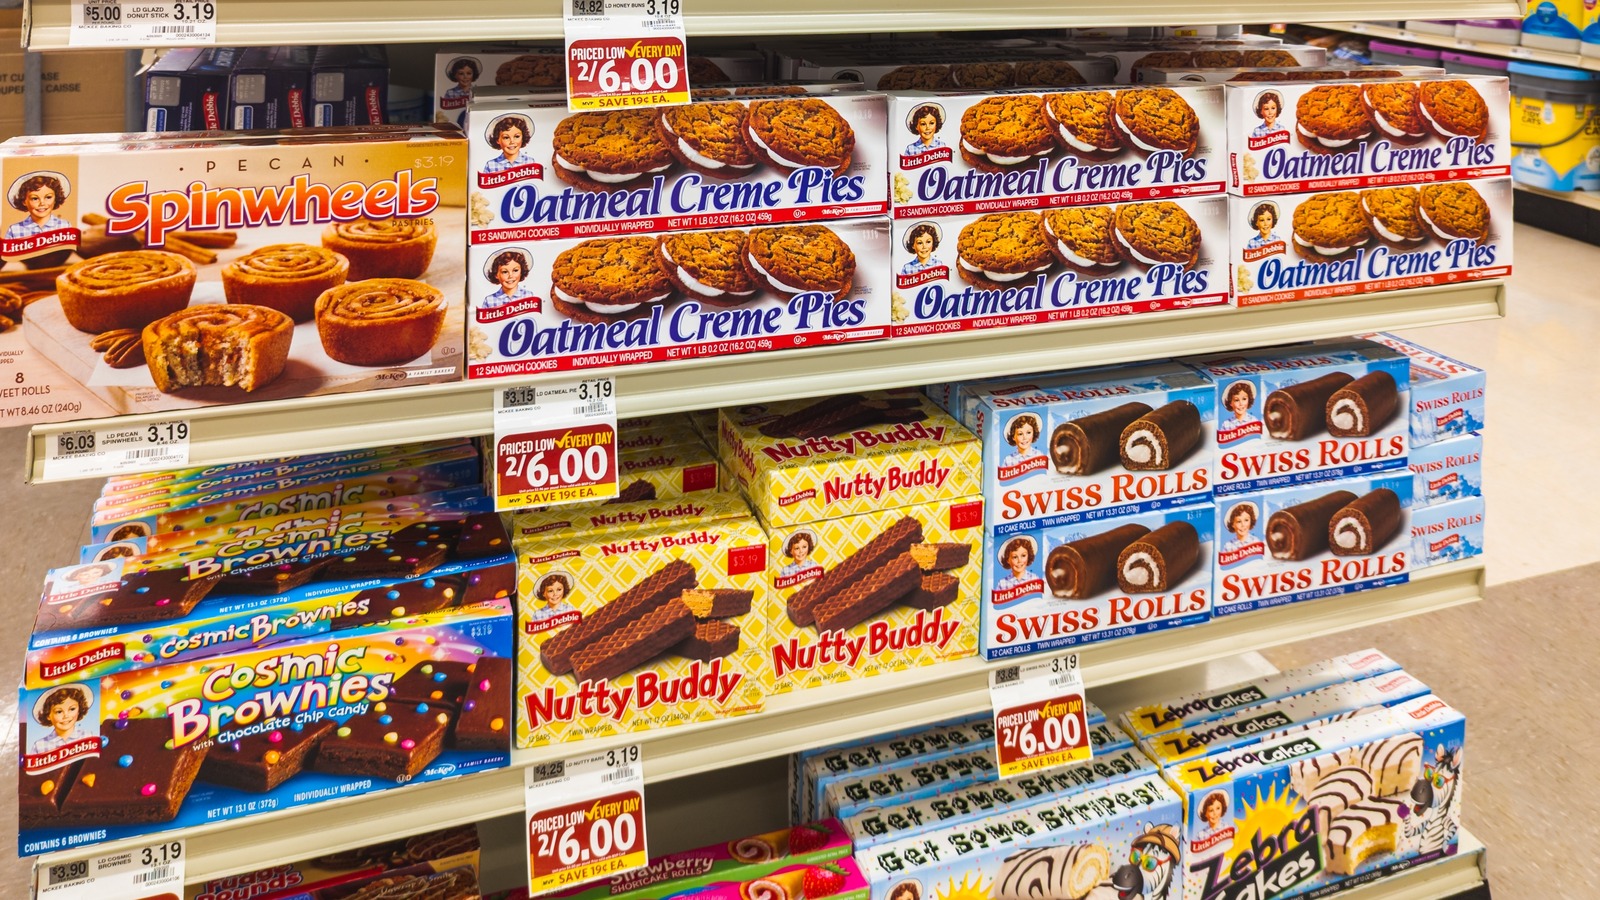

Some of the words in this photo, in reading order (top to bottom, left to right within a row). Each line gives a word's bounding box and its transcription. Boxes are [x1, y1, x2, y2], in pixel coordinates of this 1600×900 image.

[86, 6, 121, 20] $5.00
[174, 3, 214, 20] 3.19
[574, 0, 603, 13] $4.82
[571, 48, 604, 60] PRICED
[606, 46, 626, 59] LOW
[636, 45, 664, 58] EVERY
[665, 44, 682, 57] DAY
[46, 83, 81, 93] CAISSE
[599, 97, 629, 107] SAVE
[632, 96, 649, 105] 19¢
[652, 95, 670, 103] EA.
[1522, 116, 1541, 125] CATS
[206, 156, 344, 172] PECAN
[414, 156, 455, 169] $3.19
[902, 155, 923, 167] Little
[924, 150, 950, 162] Debbie
[1263, 142, 1367, 179] Oatmeal
[1370, 141, 1442, 173] Creme
[1446, 136, 1495, 166] Pies
[918, 158, 1049, 201] Oatmeal
[1052, 156, 1142, 192] Creme
[1146, 150, 1207, 183] Pies
[105, 169, 440, 248] Spinwheels
[500, 175, 666, 224] Oatmeal
[670, 173, 780, 214] Creme
[788, 166, 865, 204] Pies
[392, 218, 434, 228] PASTRIES
[478, 233, 486, 241] 12
[488, 230, 527, 240] SANDWICH
[528, 228, 559, 238] COOKIES
[574, 223, 620, 234] INDIVIDUALLY
[621, 221, 654, 231] WRAPPED
[2, 239, 34, 253] Little
[36, 231, 76, 247] Debbie
[1258, 248, 1365, 290] Oatmeal
[1368, 247, 1441, 278] Creme
[1446, 238, 1496, 269] Pies
[914, 274, 1046, 319] Oatmeal
[1050, 272, 1141, 308] Creme
[1146, 263, 1208, 296] Pies
[498, 304, 665, 358] Oatmeal
[669, 301, 782, 343] Creme
[788, 291, 866, 330] Pies
[15, 372, 25, 384] 8
[476, 368, 484, 376] 12
[486, 364, 525, 375] SANDWICH
[526, 360, 558, 372] COOKIES
[572, 356, 618, 367] INDIVIDUALLY
[620, 352, 653, 362] WRAPPED
[7, 408, 20, 416] WT
[21, 406, 39, 416] 8.46
[42, 404, 53, 414] OZ
[54, 401, 82, 413] (240g)
[506, 390, 533, 404] $3.15
[60, 434, 95, 451] $6.03
[102, 436, 143, 445] SPINWHEELS
[148, 423, 188, 442] 3.19
[500, 440, 533, 457] PRICED
[536, 438, 555, 451] LOW
[565, 434, 594, 448] EVERY
[595, 431, 613, 445] DAY
[762, 434, 855, 463] Nutty
[854, 422, 947, 448] Buddy
[1221, 449, 1310, 480] SWISS
[1318, 436, 1403, 467] ROLLS
[823, 473, 886, 505] Nutty
[888, 458, 951, 492] Buddy
[1002, 484, 1102, 520] SWISS
[1110, 468, 1208, 504] ROLLS
[526, 492, 556, 504] SAVE
[559, 490, 576, 500] 19¢
[580, 488, 597, 497] EA.
[1004, 524, 1019, 532] CAKE
[1020, 521, 1036, 530] ROLLS
[1042, 518, 1055, 526] TWIN
[1056, 514, 1081, 525] WRAPPED
[601, 540, 660, 557] Nutty
[660, 531, 720, 548] Buddy
[230, 557, 298, 576] Chocolate
[303, 552, 329, 560] Chip
[334, 544, 371, 555] Candy
[306, 585, 349, 598] INDIVIDUALLY
[350, 580, 381, 589] WRAPPED
[1222, 568, 1312, 602] SWISS
[1320, 552, 1406, 586] ROLLS
[160, 624, 251, 658] Cosmic
[250, 598, 371, 643] Brownies
[996, 608, 1099, 644] SWISS
[1108, 590, 1205, 626] ROLLS
[772, 629, 866, 679] Nutty
[868, 607, 960, 656] Buddy
[44, 661, 77, 678] Little
[79, 646, 121, 667] Debbie
[202, 644, 367, 701] Cosmic
[524, 678, 634, 730] Nutty
[636, 658, 744, 708] Buddy
[1140, 699, 1208, 729] Zebra
[1207, 687, 1264, 711] Cakes
[168, 672, 395, 750] Brownies
[193, 740, 214, 751] with
[218, 717, 291, 744] Chocolate
[295, 711, 324, 724] Chip
[328, 703, 369, 718] Candy
[1164, 724, 1233, 754] Zebra
[1232, 713, 1290, 737] Cakes
[27, 755, 57, 769] Little
[59, 741, 98, 760] Debbie
[1022, 758, 1045, 771] SAVE
[1046, 755, 1060, 765] 19¢
[1062, 753, 1076, 761] EA.
[1188, 752, 1259, 784] Zebra
[1258, 740, 1317, 764] Cakes
[208, 809, 221, 819] NET
[222, 807, 234, 816] WT
[235, 804, 247, 814] 13.1
[248, 803, 256, 811] OZ
[258, 798, 279, 811] (372g)
[294, 786, 339, 802] INDIVIDUALLY
[340, 780, 372, 792] WRAPPED
[532, 815, 564, 835] PRICED
[566, 810, 585, 826] LOW
[595, 802, 621, 820] EVERY
[624, 797, 640, 812] DAY
[862, 805, 923, 837] Get
[24, 836, 60, 853] CONTAINS
[62, 838, 67, 846] 6
[68, 830, 107, 845] BROWNIES
[1190, 804, 1320, 899] Zebra
[52, 863, 86, 878] $3.90
[108, 854, 132, 863] COSMIC
[610, 857, 714, 886] Strawberry
[877, 842, 940, 873] Get
[611, 873, 670, 894] SHORTCAKE
[672, 868, 703, 879] ROLLS
